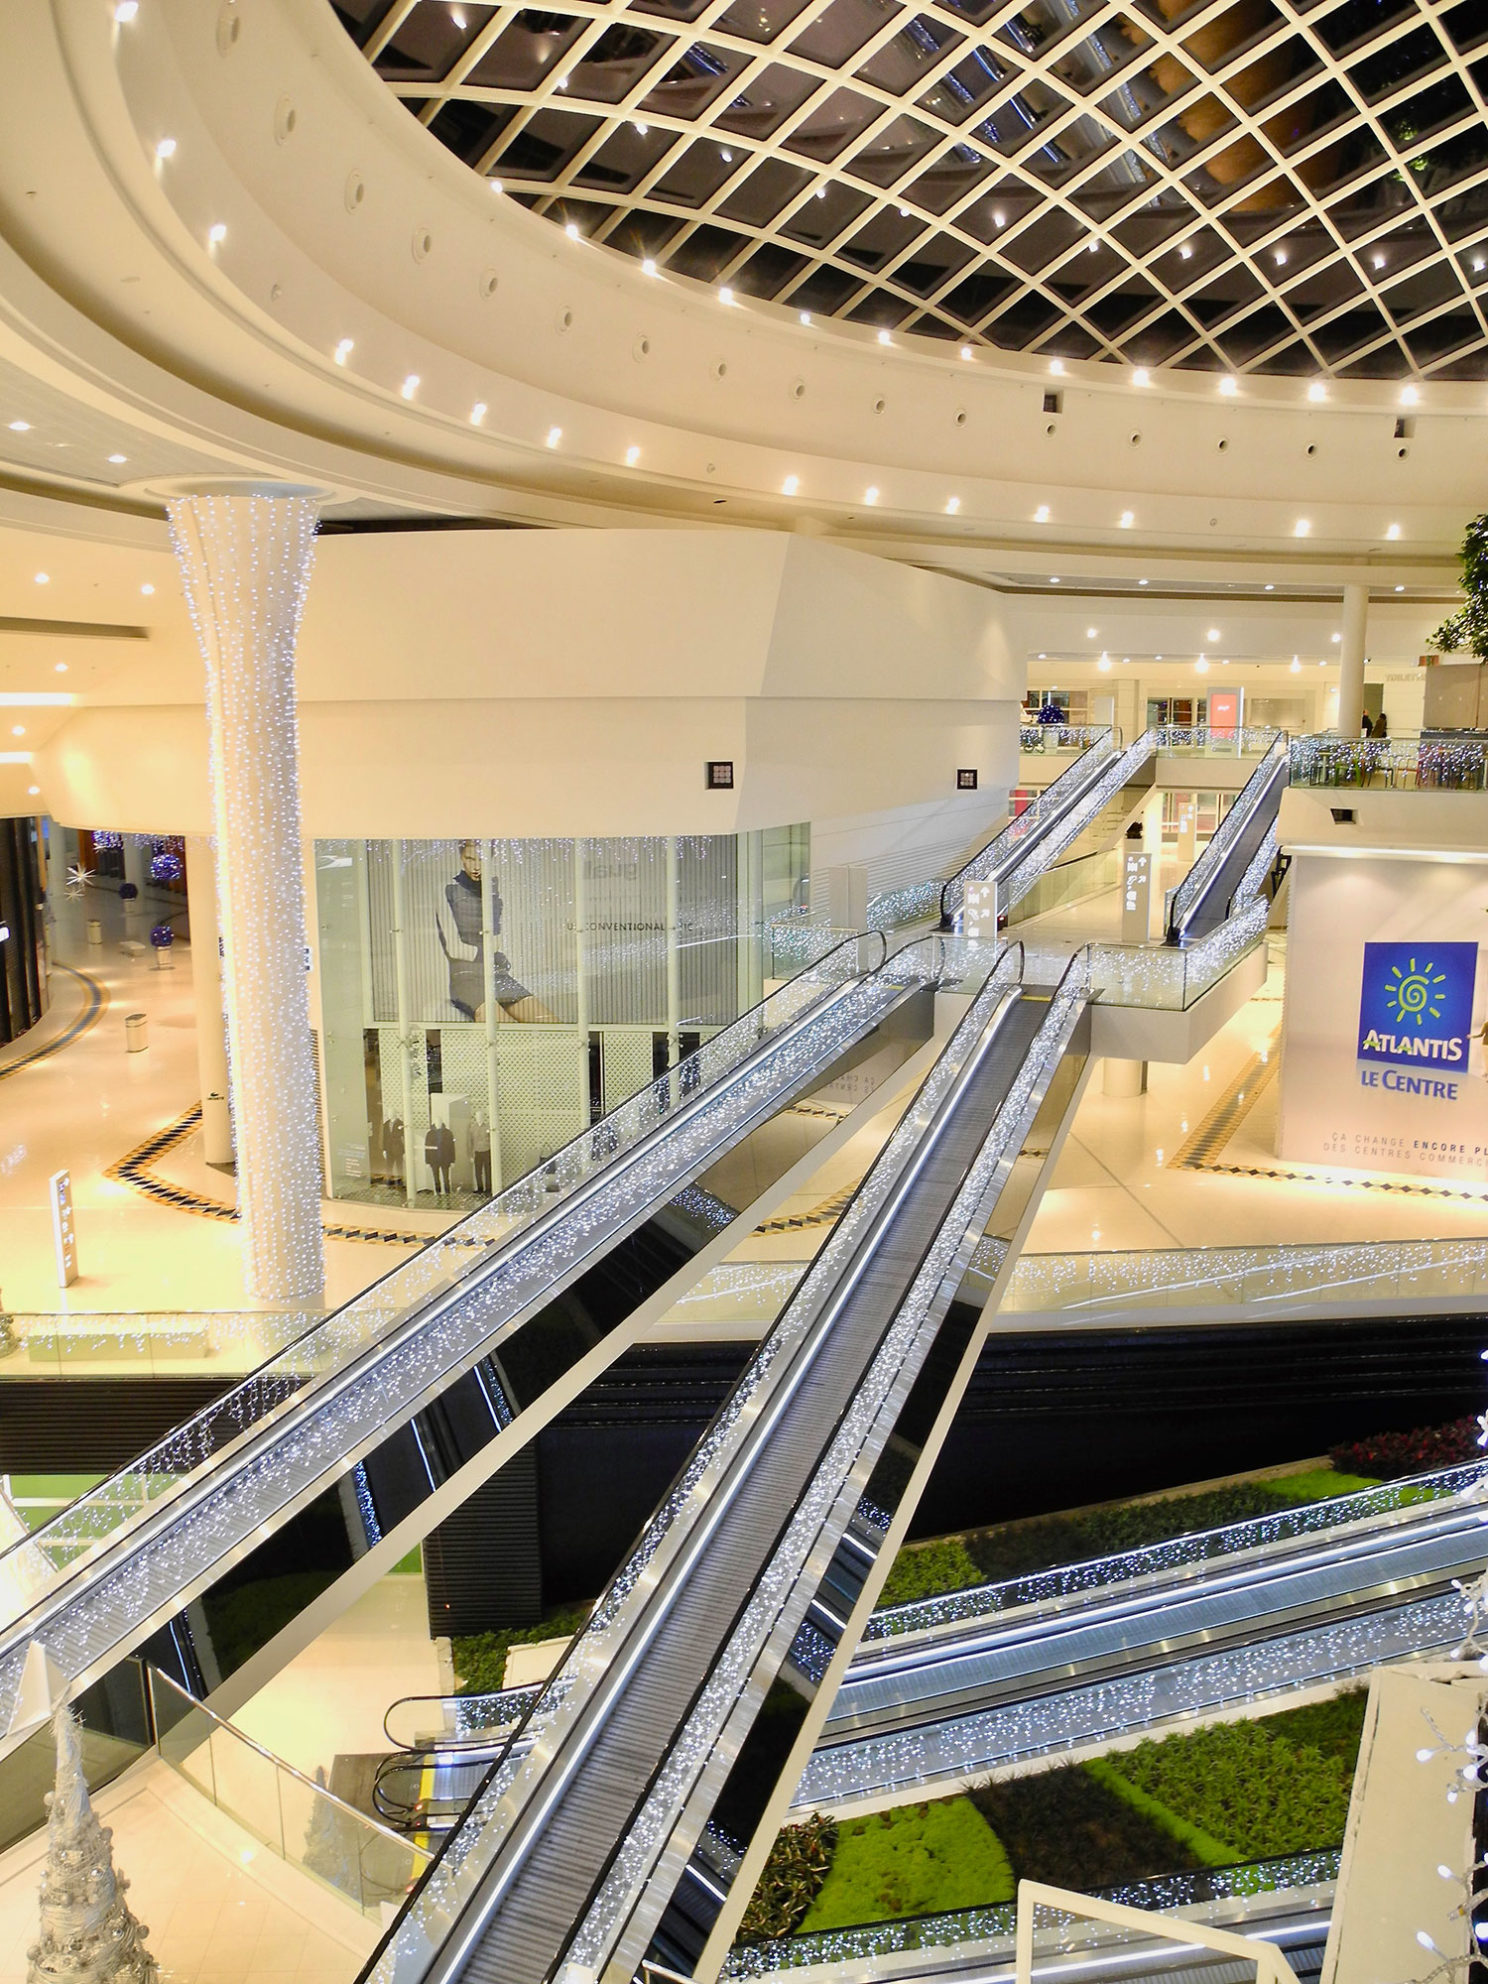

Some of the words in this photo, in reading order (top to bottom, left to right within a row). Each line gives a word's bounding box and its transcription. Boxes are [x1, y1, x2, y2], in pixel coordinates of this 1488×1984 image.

[567, 921, 665, 932] UCONVENTIONAL
[1363, 1029, 1463, 1061] ATLANTIS
[1361, 1070, 1379, 1087] LE
[1382, 1069, 1459, 1100] CENTRE
[1323, 1142, 1346, 1153] DES
[1354, 1146, 1411, 1159] CENTRES
[1355, 1134, 1405, 1148] CHANGE
[1413, 1140, 1465, 1153] ENCORE
